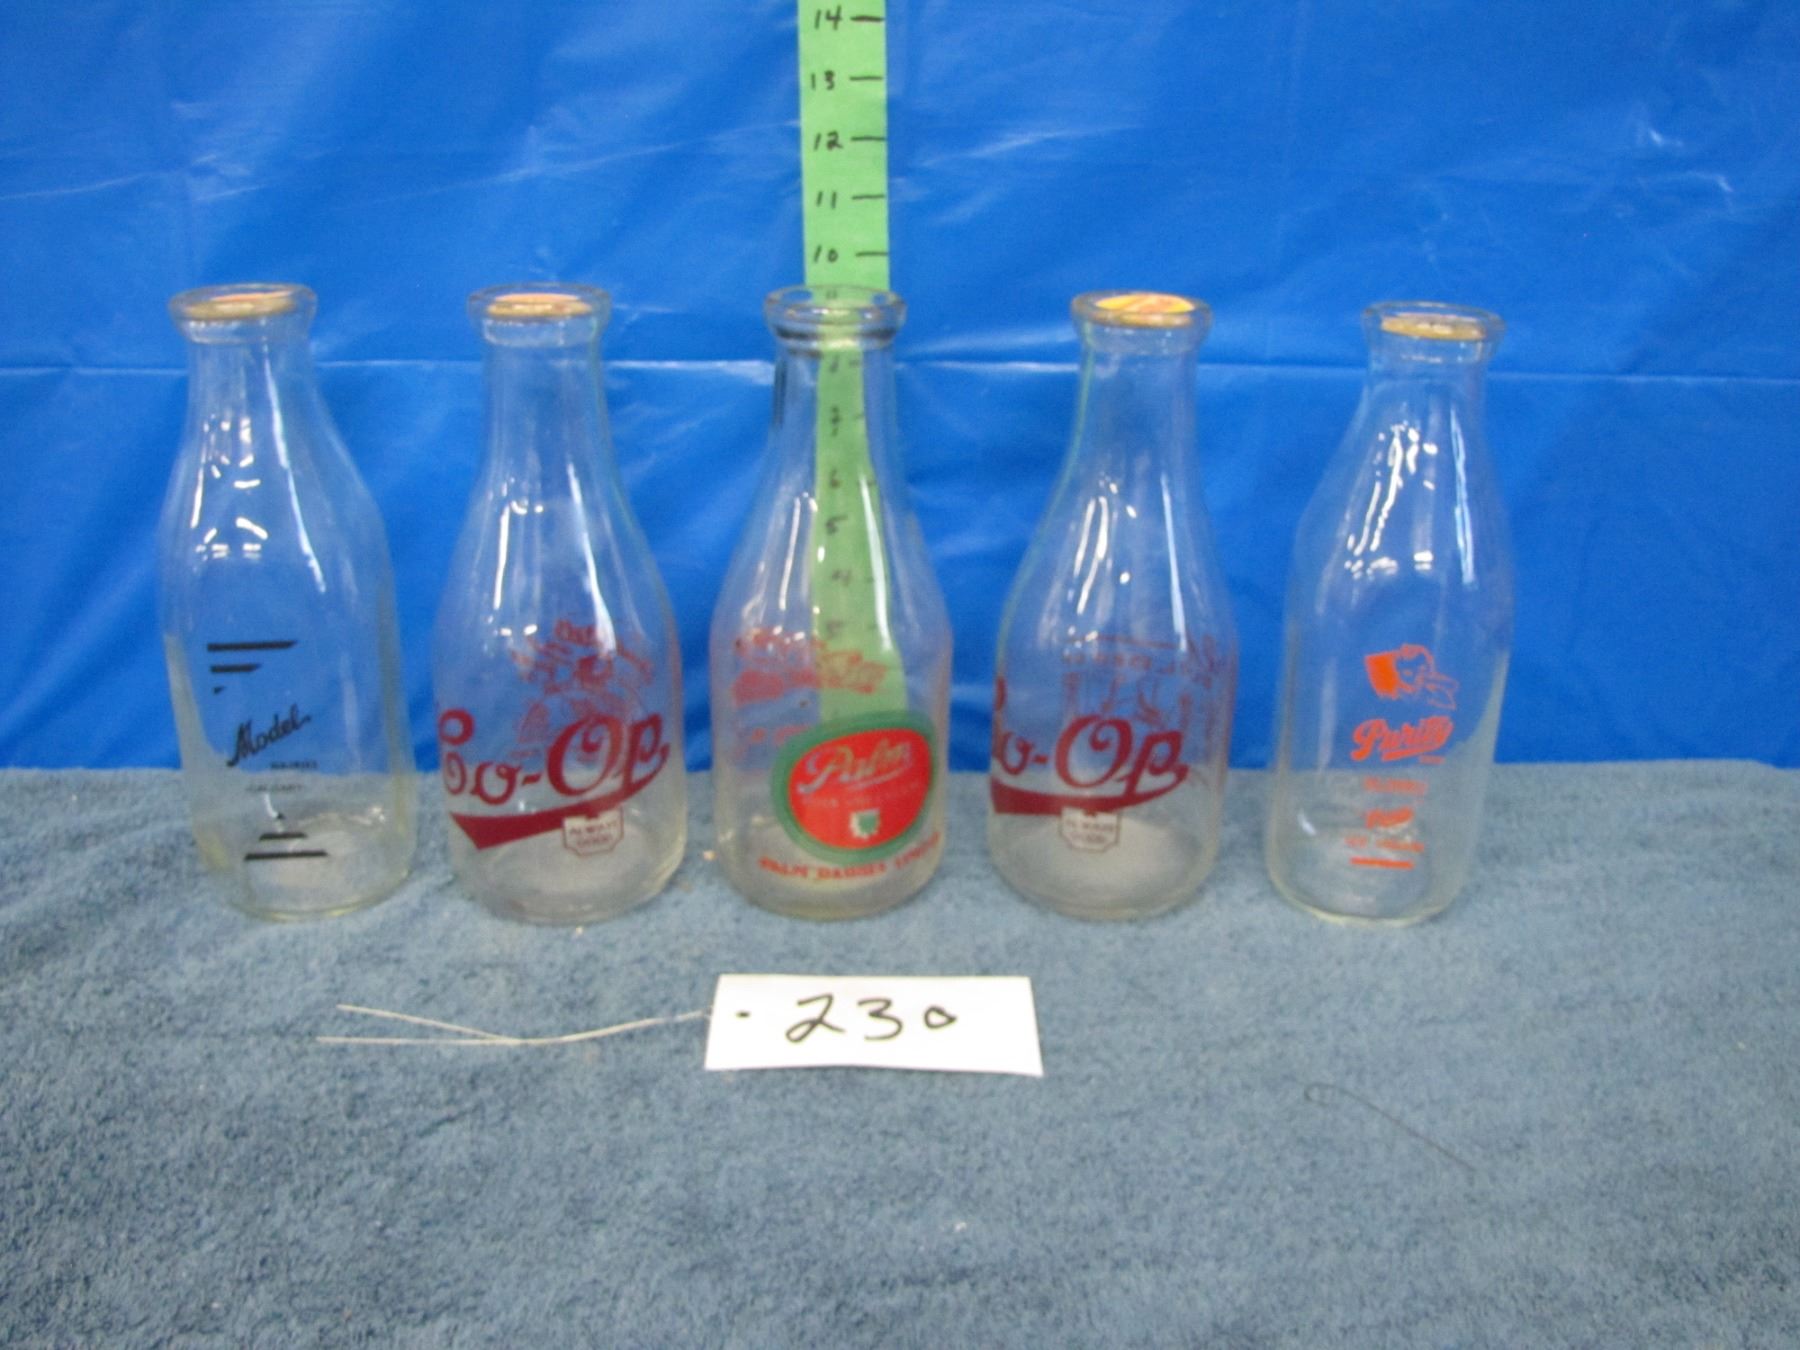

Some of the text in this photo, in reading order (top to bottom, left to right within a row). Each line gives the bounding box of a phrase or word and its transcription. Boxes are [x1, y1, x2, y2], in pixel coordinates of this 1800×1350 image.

[814, 5, 842, 30] 14
[810, 69, 835, 91] 13
[814, 131, 843, 150] 12
[816, 191, 837, 209] 11
[814, 245, 838, 263] 10
[226, 703, 311, 767] Model
[786, 994, 957, 1043] 230
